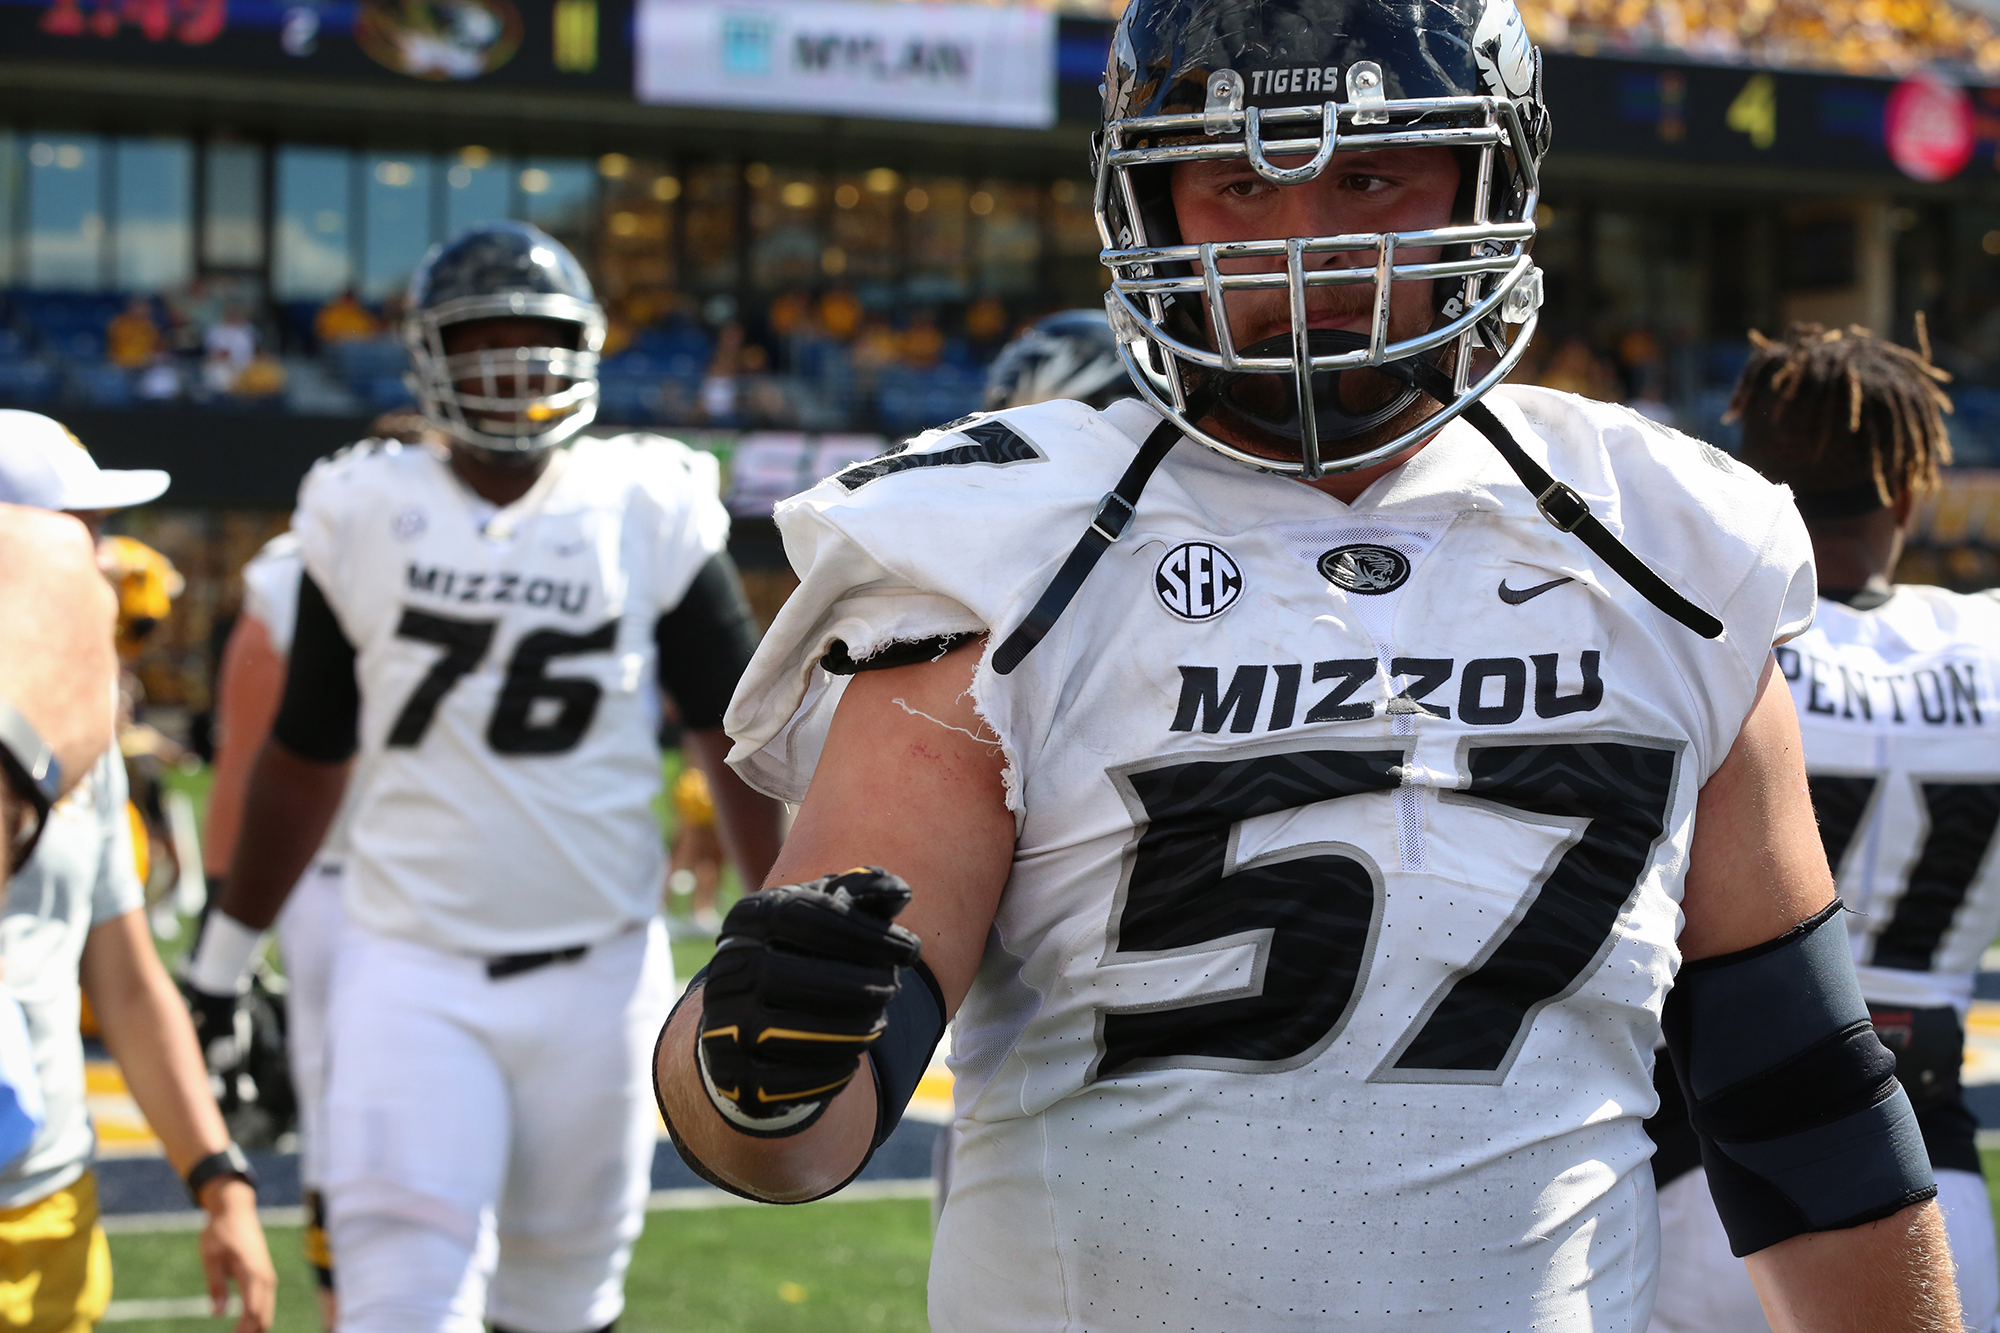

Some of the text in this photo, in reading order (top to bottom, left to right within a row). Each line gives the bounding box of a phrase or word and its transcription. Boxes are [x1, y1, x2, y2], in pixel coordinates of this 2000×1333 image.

[1252, 67, 1338, 96] TIGERS
[1725, 72, 1776, 149] 4
[405, 562, 591, 616] MIZZOU
[1160, 545, 1237, 615] SEC
[384, 603, 620, 759] 76
[1170, 650, 1604, 733] MIZZOU
[1086, 730, 1690, 1086] 57
